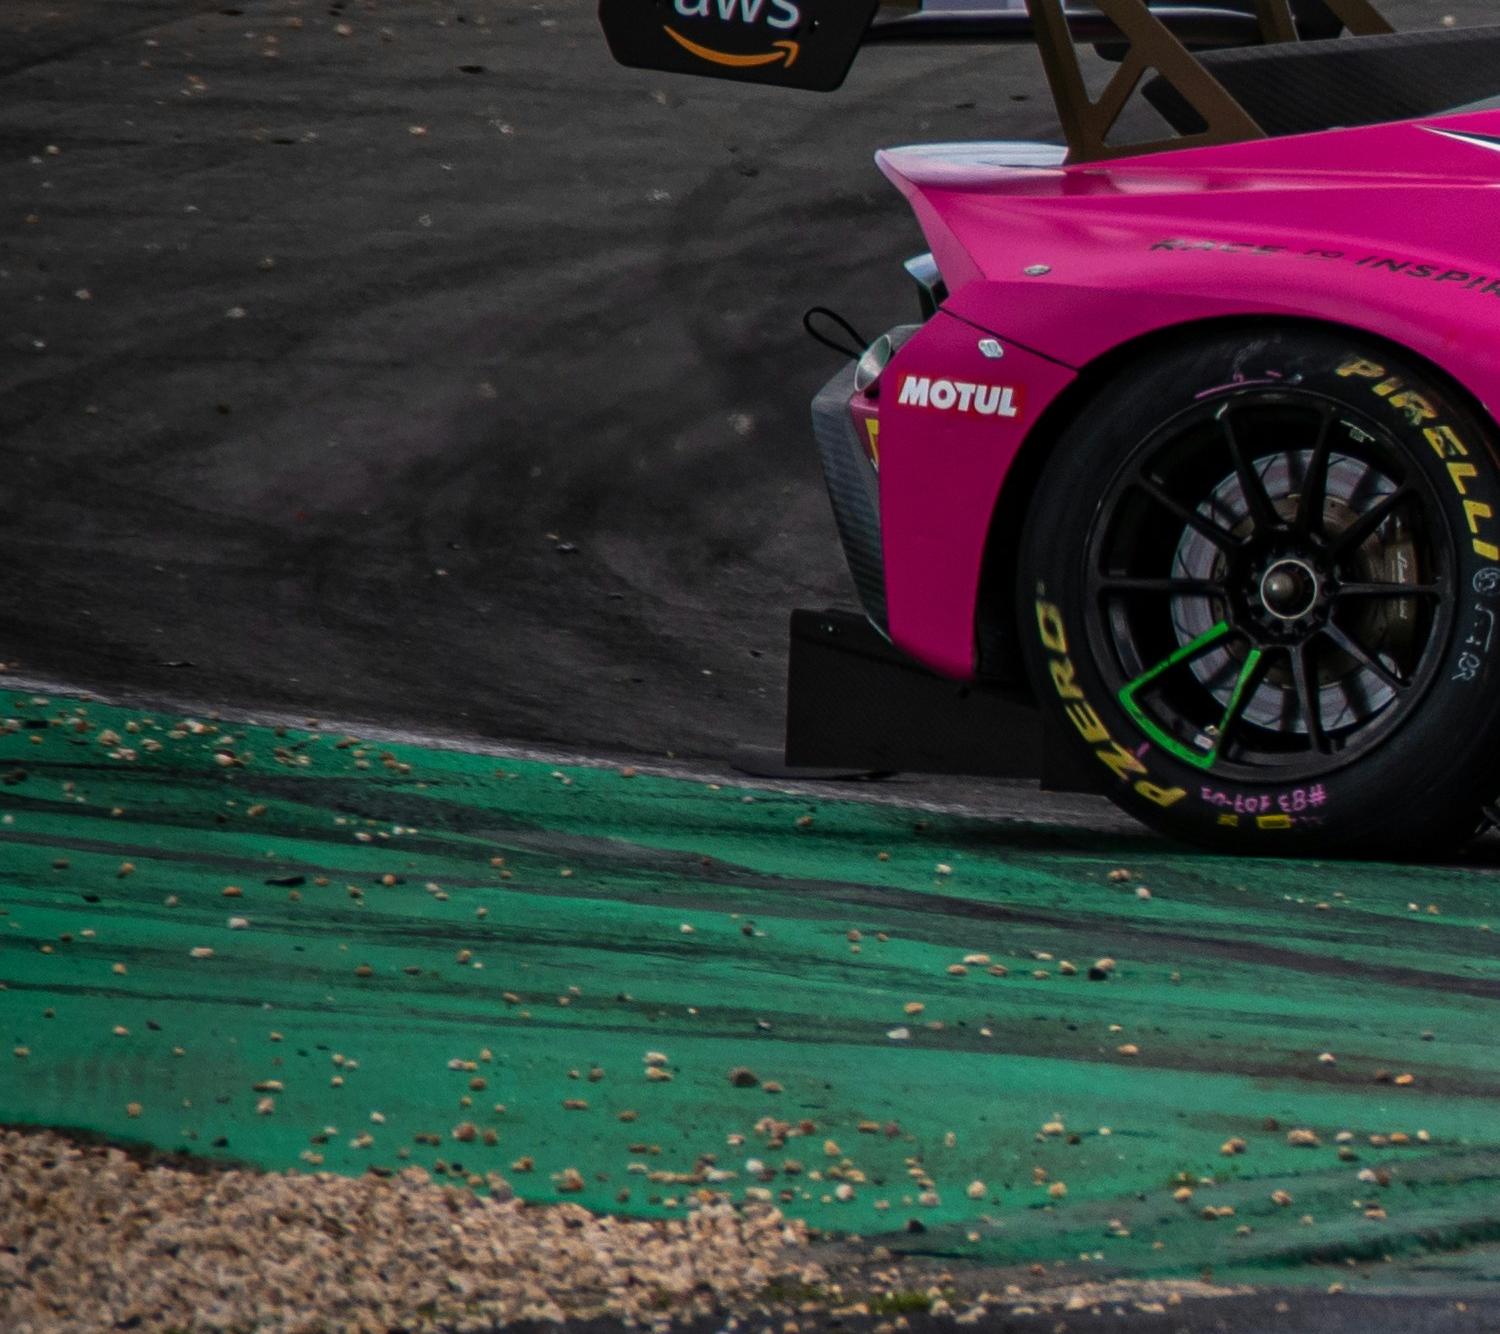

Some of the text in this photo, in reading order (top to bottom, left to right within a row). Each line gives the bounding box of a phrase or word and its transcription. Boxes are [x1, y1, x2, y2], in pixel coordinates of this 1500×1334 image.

[898, 375, 1017, 417] MOTUL
[1335, 358, 1500, 561] PIRELLI
[1036, 600, 1148, 781] ZERO
